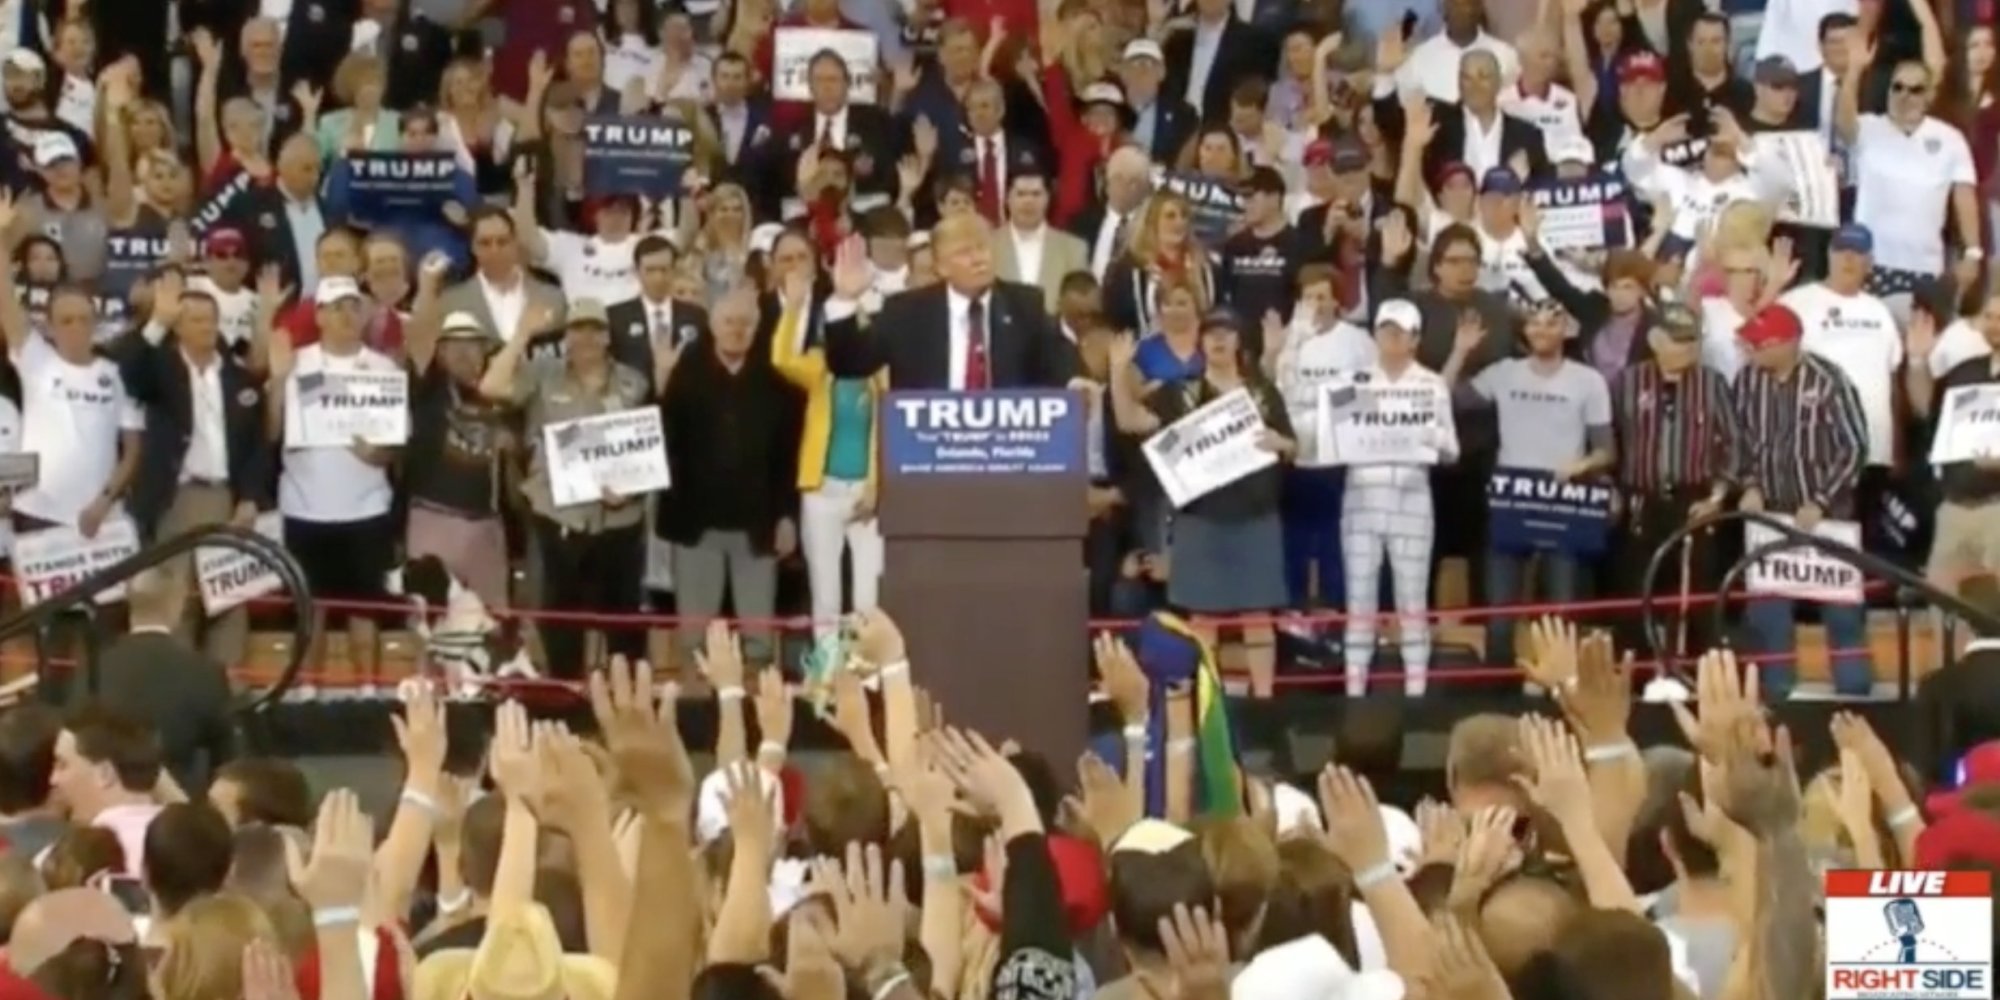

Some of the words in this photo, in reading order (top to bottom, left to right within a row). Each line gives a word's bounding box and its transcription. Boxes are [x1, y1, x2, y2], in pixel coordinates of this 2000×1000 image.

[585, 125, 693, 146] TRUMP
[350, 159, 455, 178] TRUMP
[1532, 182, 1621, 206] RUMP
[319, 393, 405, 409] TRUMP
[1510, 389, 1569, 403] TRUMP
[895, 398, 1068, 428] TRUMP
[1352, 410, 1435, 427] TRUMP
[1184, 412, 1258, 459] TRUMP
[579, 435, 661, 463] TRUMP
[991, 445, 1036, 459] Florida
[1491, 474, 1611, 504] TRUMP
[1755, 554, 1853, 588] TRUMP
